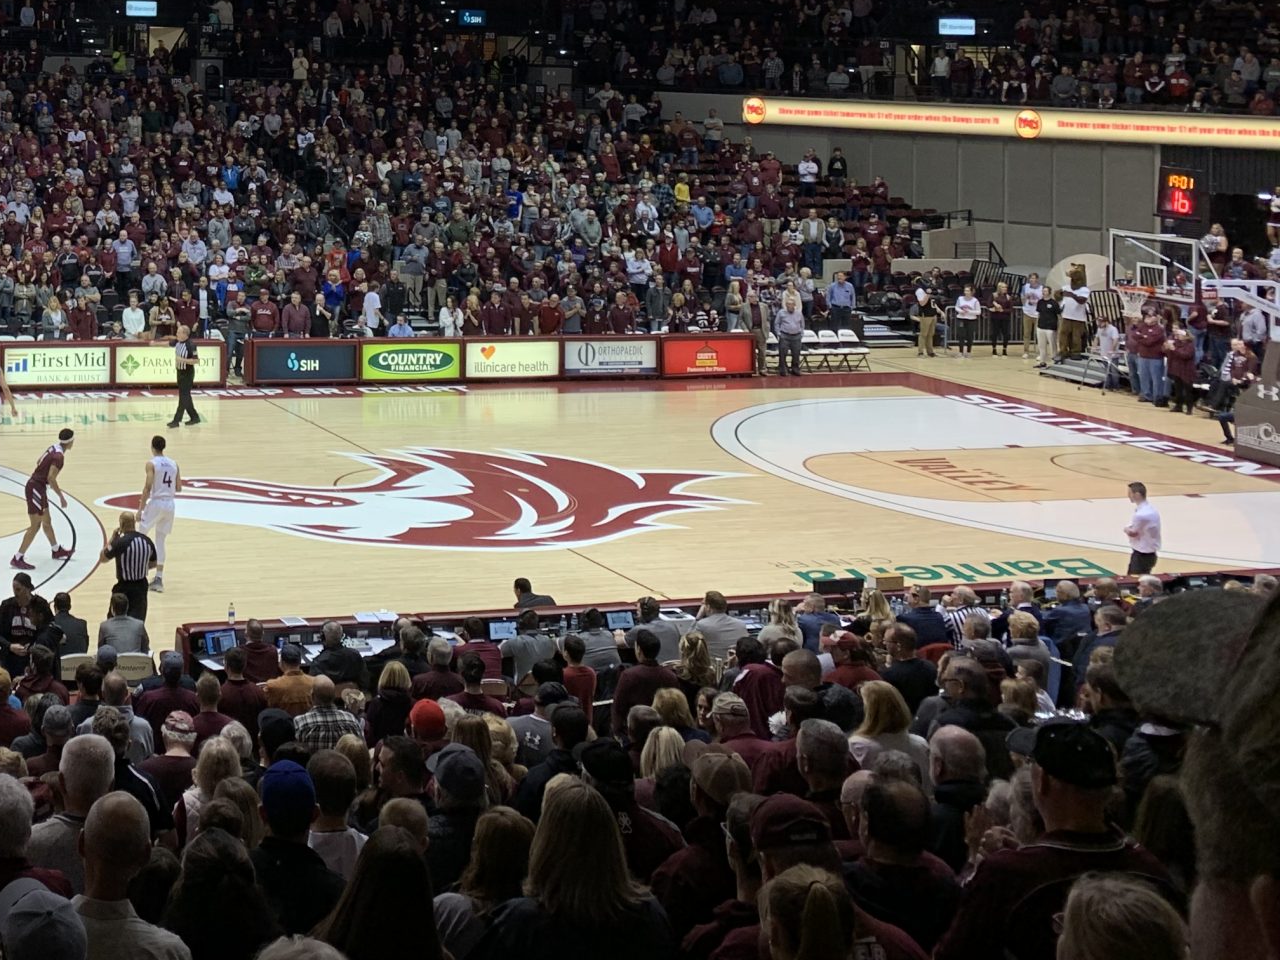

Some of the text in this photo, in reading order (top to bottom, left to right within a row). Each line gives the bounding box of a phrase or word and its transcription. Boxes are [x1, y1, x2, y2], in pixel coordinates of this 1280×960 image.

[1169, 174, 1194, 189] 19:01
[1174, 191, 1190, 214] 16
[598, 346, 643, 356] ORTHOPAEDIC
[32, 352, 106, 368] First Mid
[142, 357, 172, 367] FARM
[300, 359, 319, 371] SIH
[379, 352, 443, 366] COUNTRY
[391, 364, 434, 372] FINANCIAL
[474, 361, 548, 372] illinicare health
[73, 374, 101, 382] TRUST
[13, 390, 129, 400] HARRY
[292, 388, 354, 396] SR.
[357, 386, 470, 394] COURT
[945, 394, 1280, 476] SOUTHERN
[162, 472, 173, 488] 4
[894, 457, 1052, 491] VALLEY
[776, 556, 892, 569] CENTER
